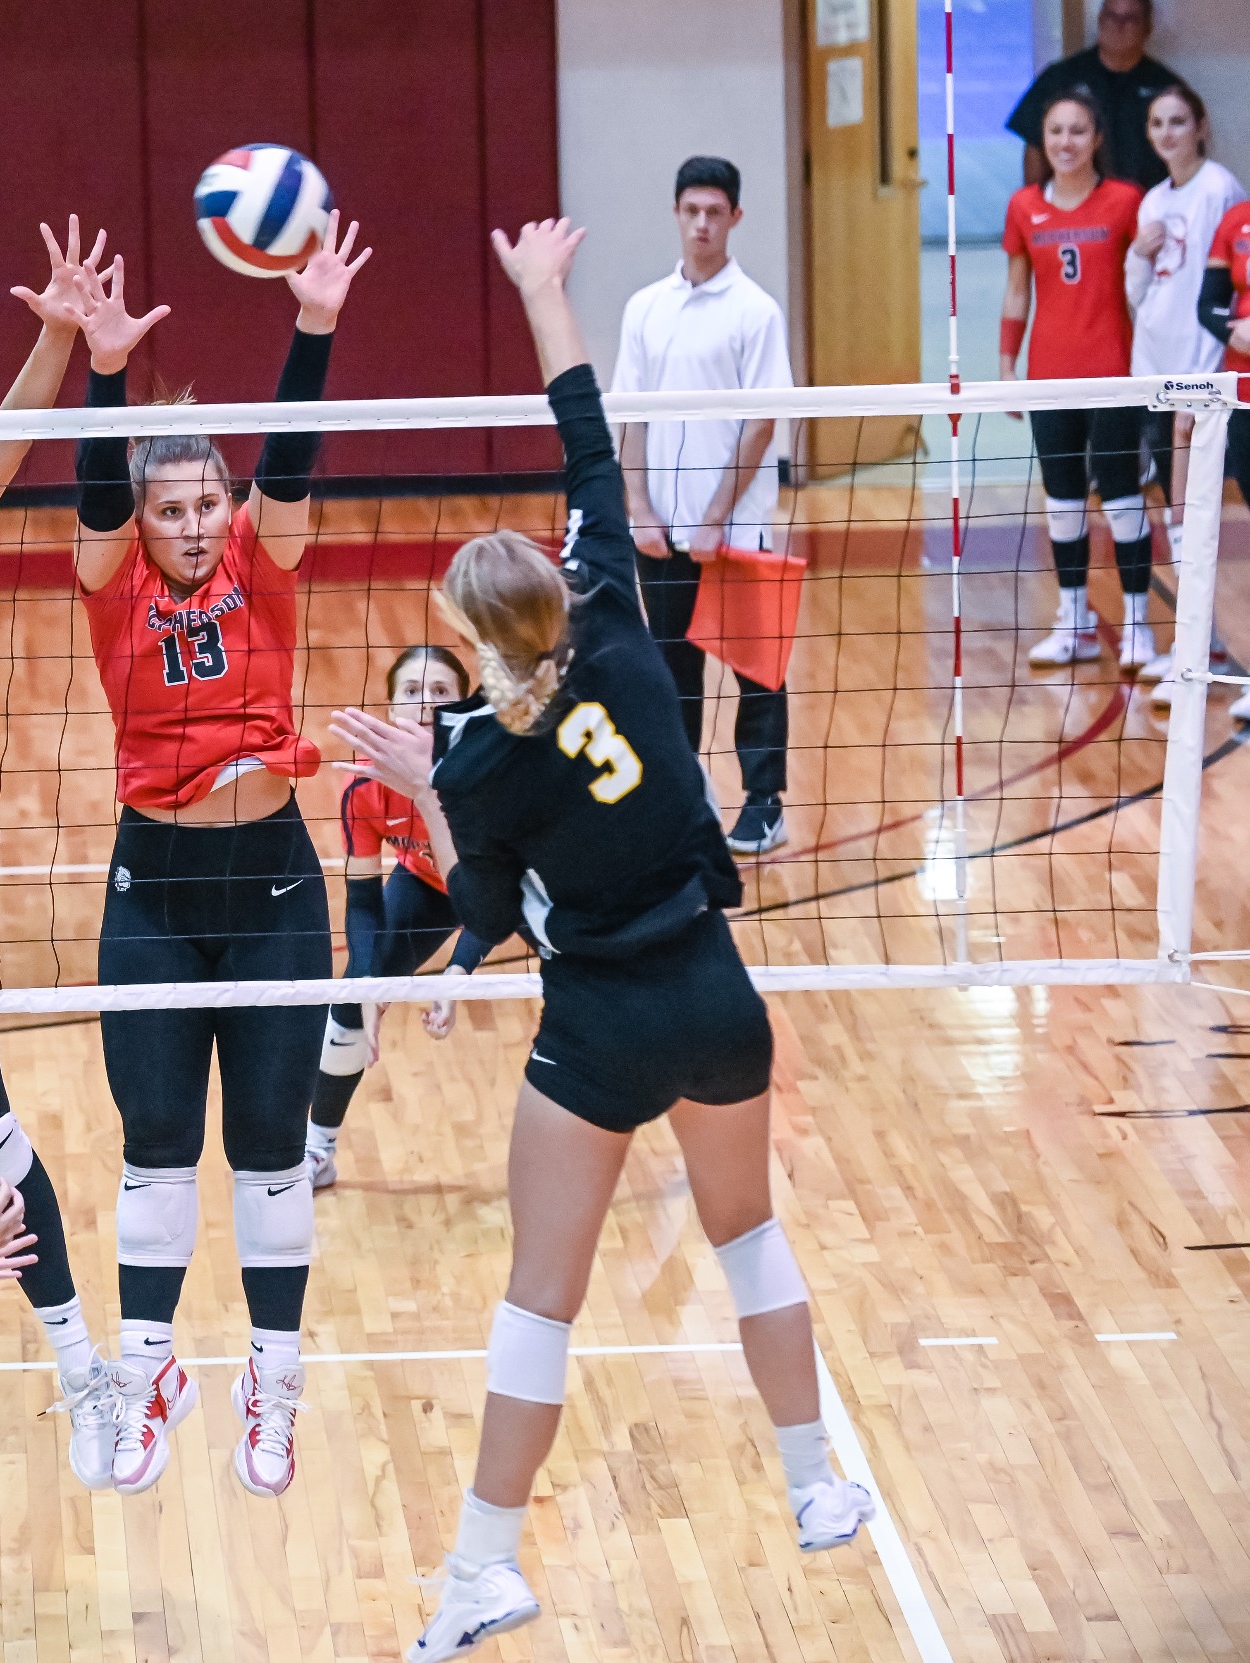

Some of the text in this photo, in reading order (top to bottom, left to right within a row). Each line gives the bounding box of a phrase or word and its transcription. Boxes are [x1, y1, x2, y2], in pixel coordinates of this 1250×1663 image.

[1058, 243, 1081, 285] 3
[1175, 381, 1214, 391] Senoh
[158, 620, 229, 686] 13
[556, 701, 644, 804] 3
